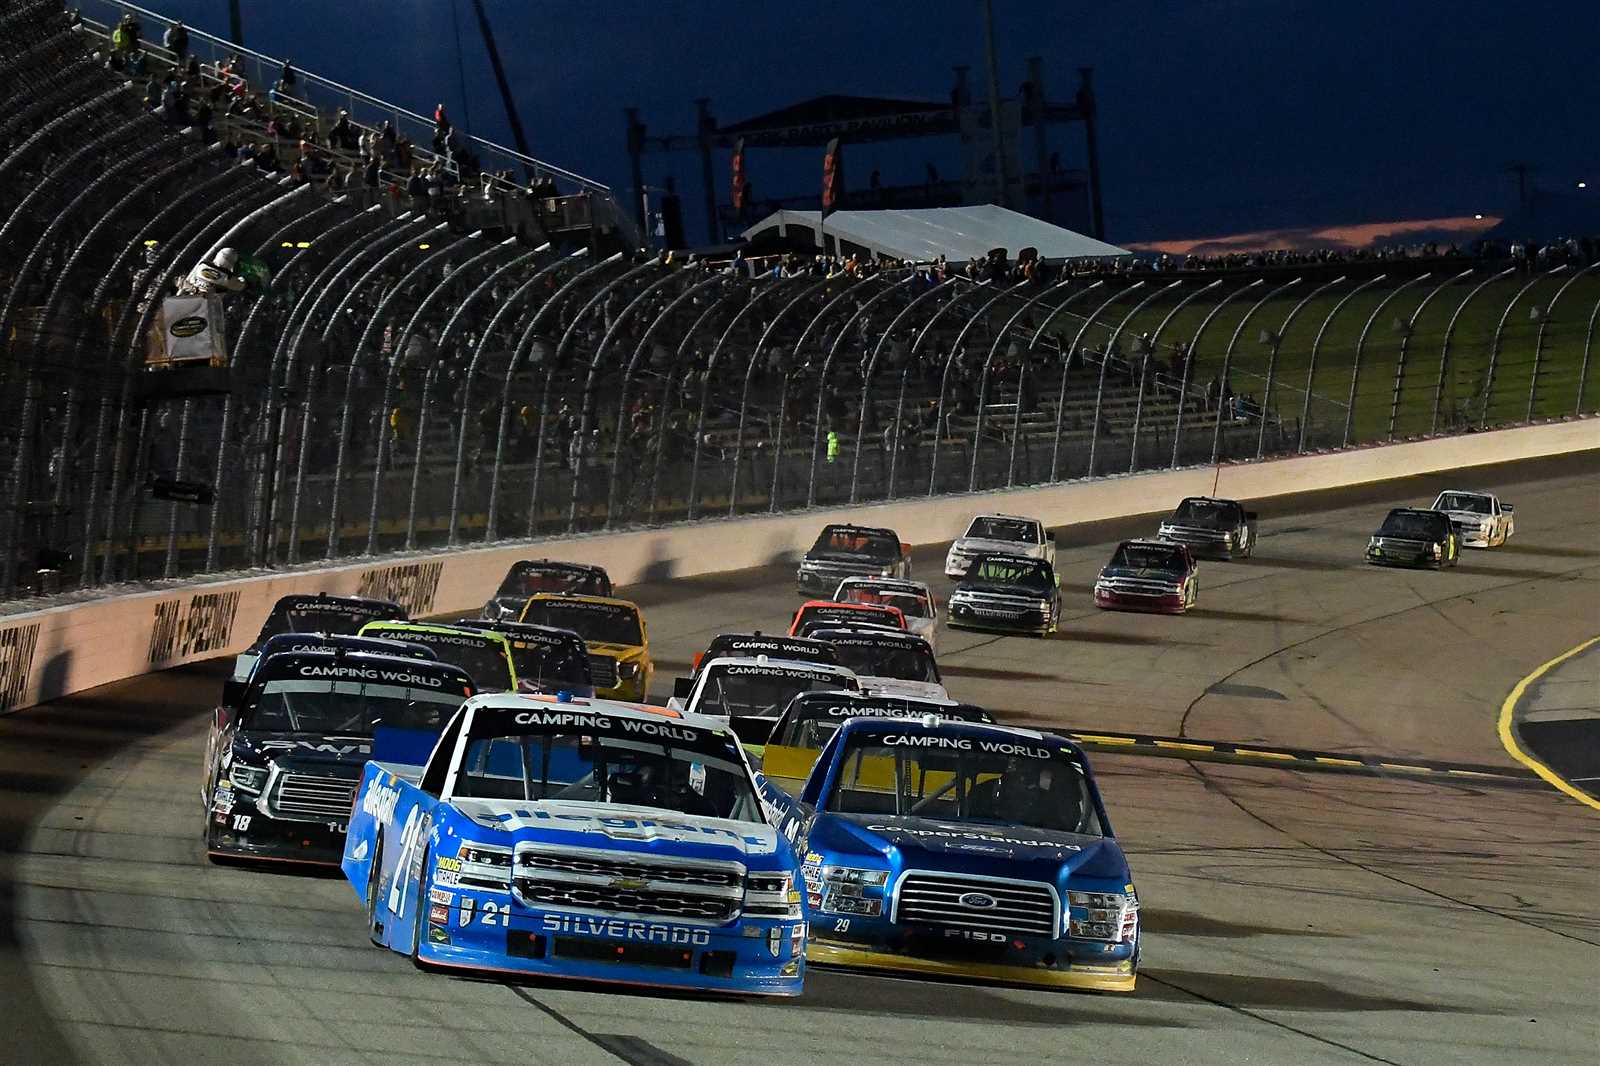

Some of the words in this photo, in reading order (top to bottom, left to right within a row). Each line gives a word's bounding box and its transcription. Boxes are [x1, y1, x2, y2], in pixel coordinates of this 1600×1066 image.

[295, 602, 343, 612] CAMPING
[344, 606, 382, 616] WORLD
[546, 601, 586, 609] CAMPING
[587, 604, 621, 613] WORLD
[379, 632, 437, 643] CAMPING
[440, 637, 487, 649] WORLD
[522, 633, 562, 645] WORLD
[832, 639, 873, 647] CAMPING
[877, 641, 912, 649] WORLD
[732, 641, 778, 650] CAMPING
[782, 644, 820, 655] WORLD
[300, 666, 378, 679] CAMPING
[380, 671, 442, 687] WORLD
[727, 666, 784, 677] CAMPING
[785, 670, 831, 682] WORLD
[828, 706, 903, 718] CAMPING
[514, 712, 611, 729] CAMPING
[621, 719, 698, 742] WORLD
[883, 734, 972, 750] CAMPING
[978, 741, 1051, 759] WORLD
[233, 813, 252, 831] 18
[438, 856, 461, 873] MOOG
[481, 901, 511, 927] 21
[542, 913, 711, 946] SILVERADO
[834, 918, 851, 933] 29
